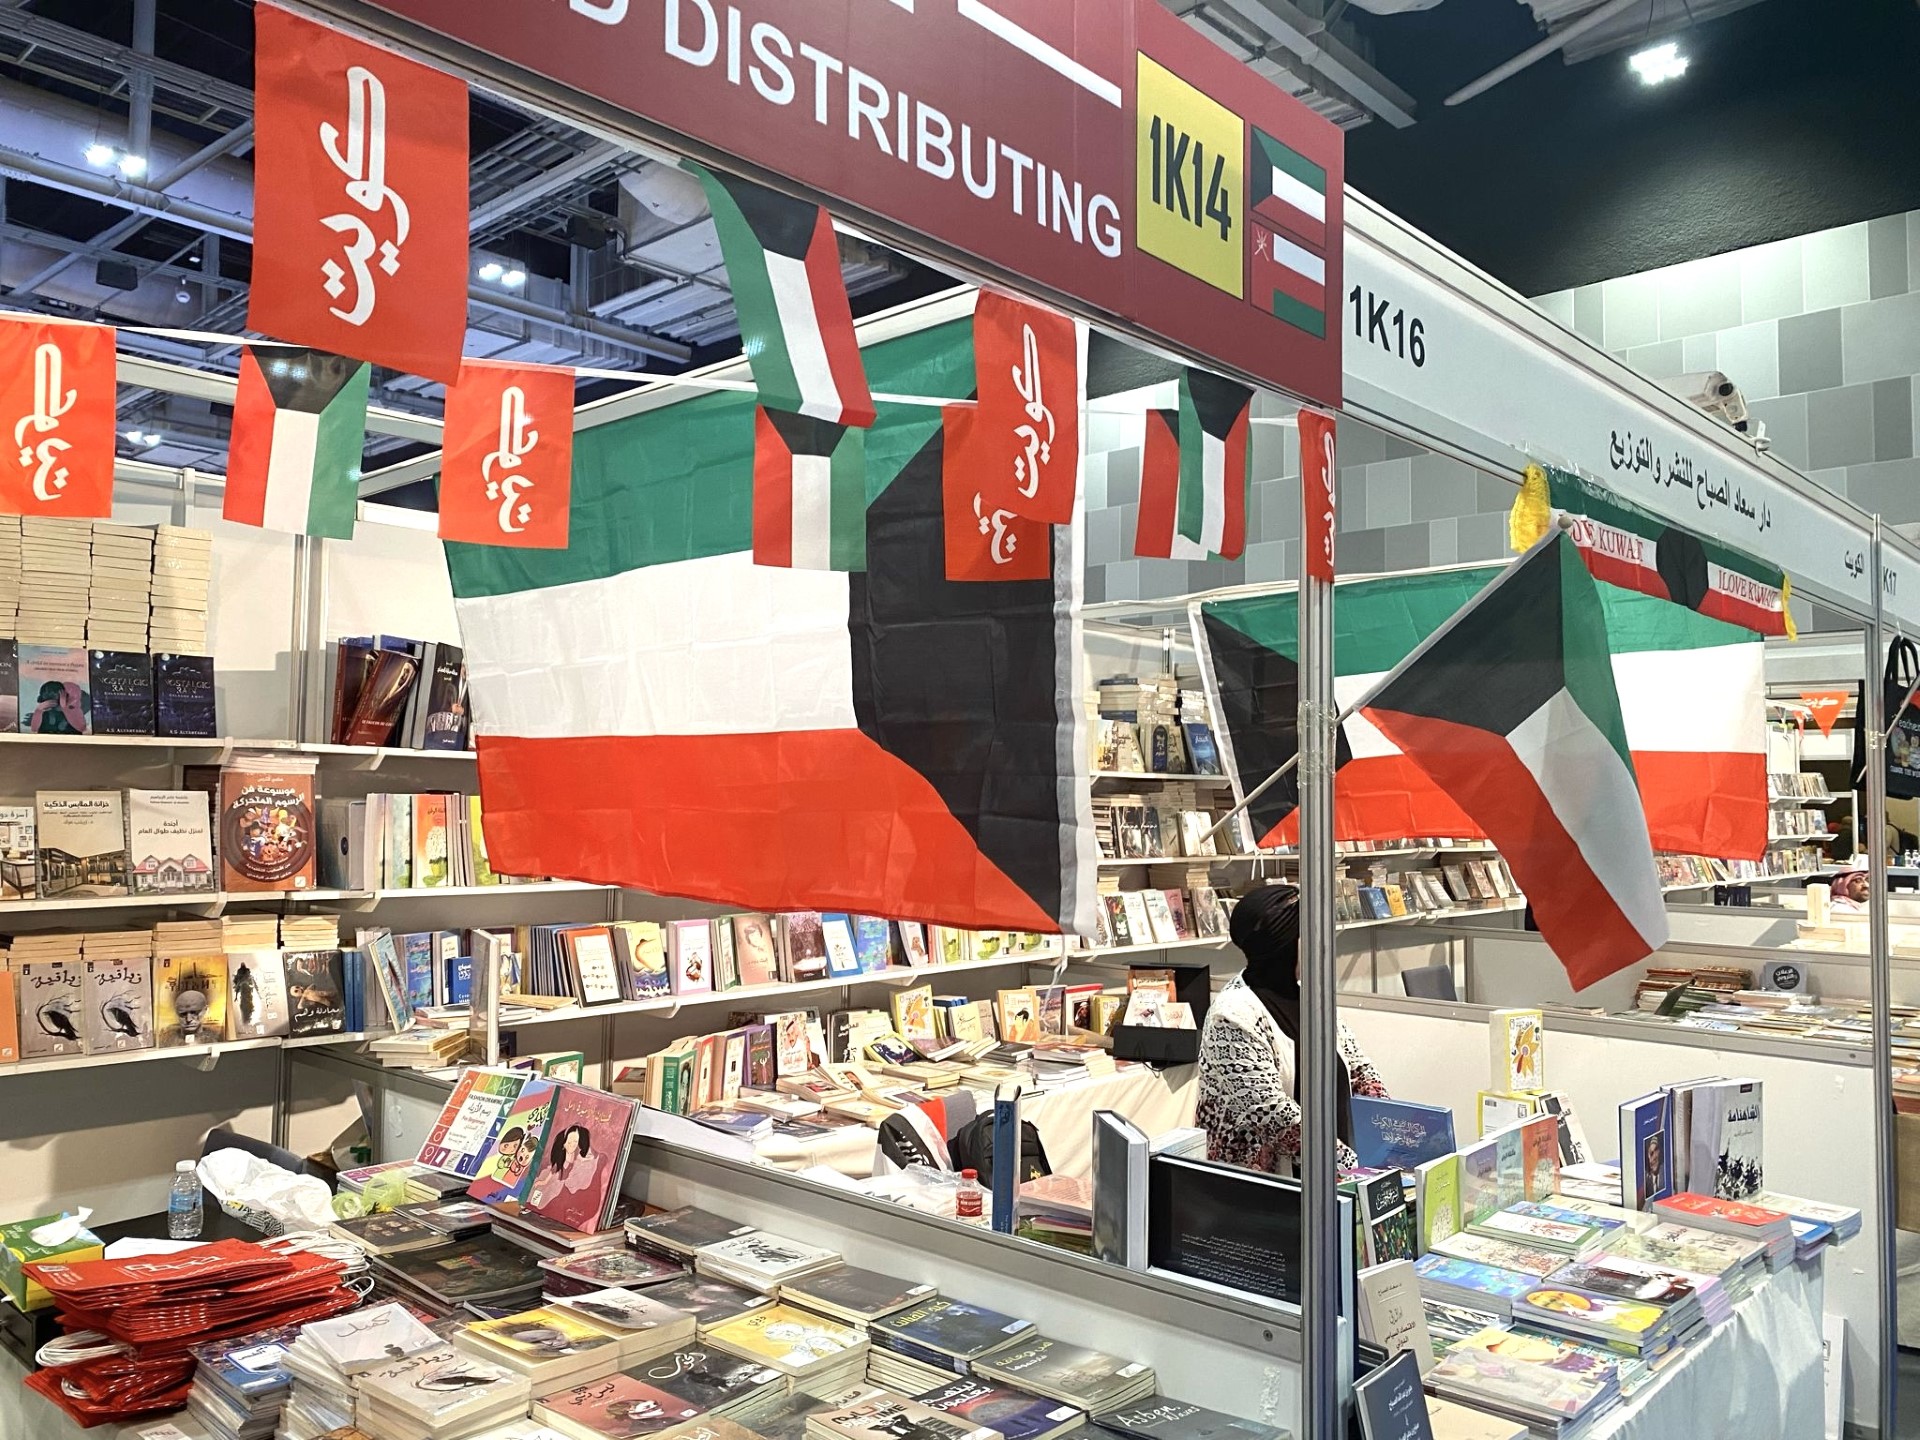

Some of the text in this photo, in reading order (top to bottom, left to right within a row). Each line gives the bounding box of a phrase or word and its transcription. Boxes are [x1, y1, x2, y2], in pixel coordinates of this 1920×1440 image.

[664, 0, 1122, 259] DISTRIBUTING
[1149, 115, 1232, 242] 1K14
[1349, 285, 1426, 368] 1K16
[1610, 430, 1771, 532] دار سعاد الصباح للنشر والتوزيع
[176, 686, 197, 694] RAN
[232, 793, 305, 809] الرسوم المتحركة
[258, 784, 296, 796] موسوعة
[1728, 1104, 1759, 1122] الشاهنامة
